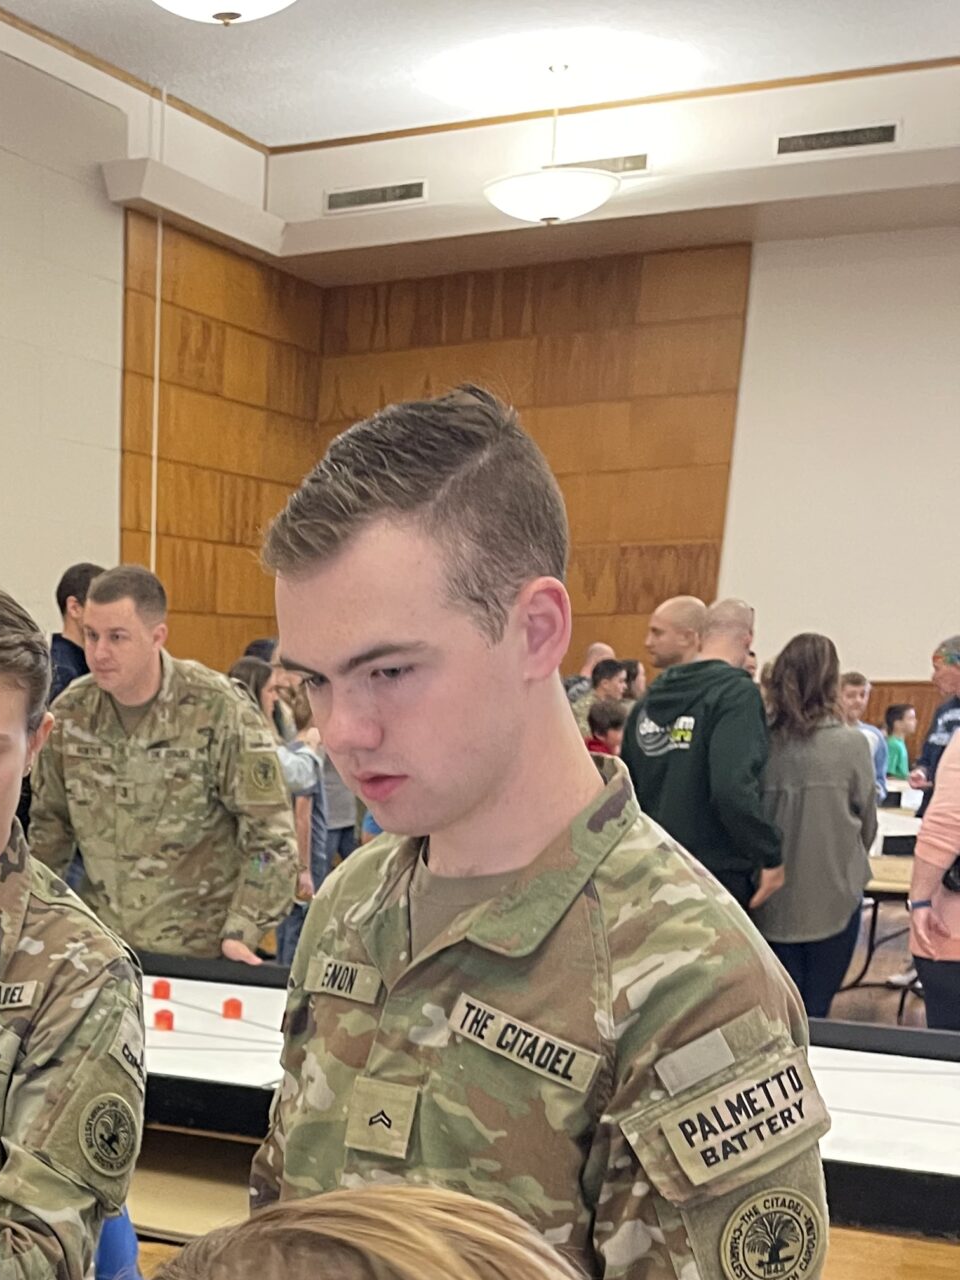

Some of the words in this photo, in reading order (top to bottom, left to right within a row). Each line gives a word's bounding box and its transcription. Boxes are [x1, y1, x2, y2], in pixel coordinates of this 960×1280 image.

[459, 1002, 494, 1040] THE
[496, 1023, 578, 1081] CITADEL
[678, 1065, 803, 1148] PALMETTO
[700, 1098, 806, 1168] BATTERY
[740, 1205, 760, 1224] THE
[763, 1197, 804, 1217] CITADEL
